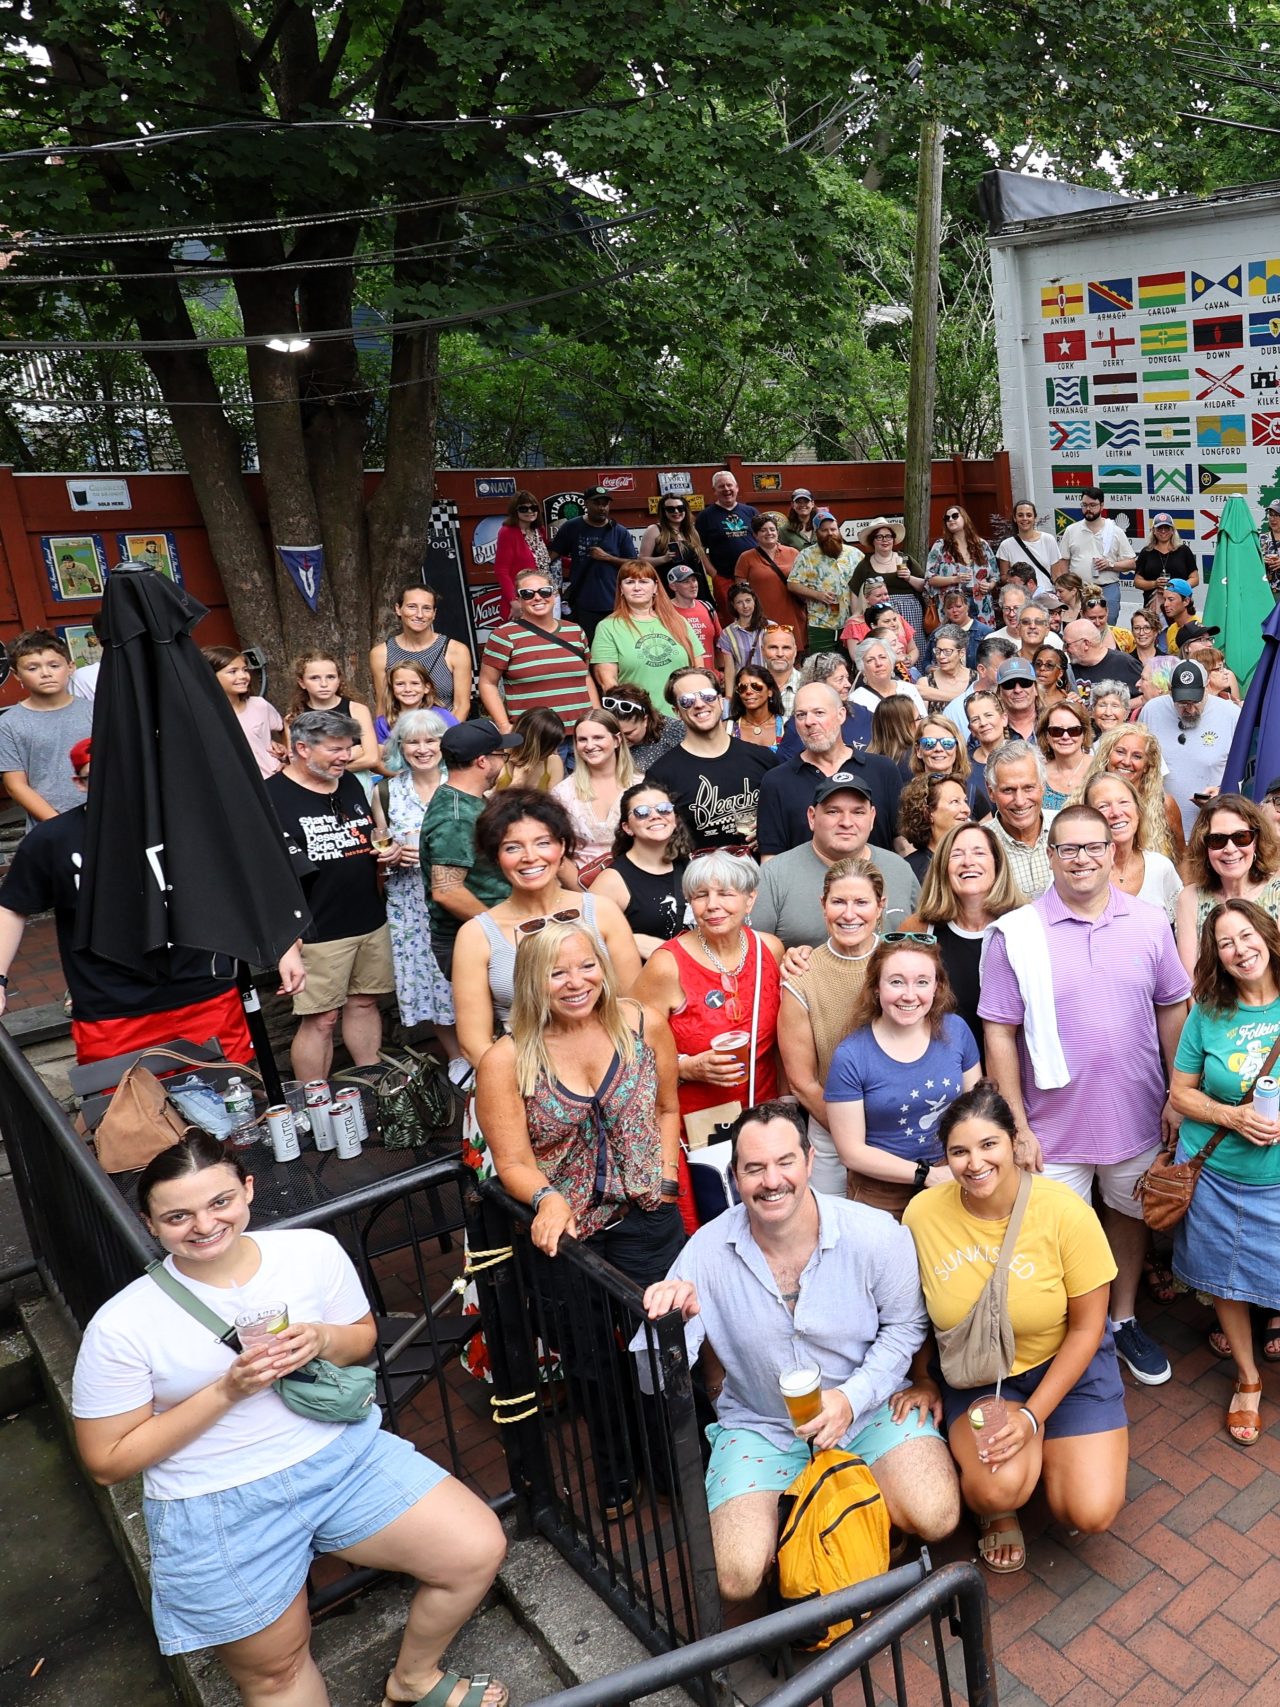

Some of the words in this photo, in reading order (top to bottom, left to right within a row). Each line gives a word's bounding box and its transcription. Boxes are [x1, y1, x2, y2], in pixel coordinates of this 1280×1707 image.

[1204, 301, 1230, 311] CAVAN
[1148, 307, 1177, 316] CARLOW
[1050, 317, 1076, 325] ANTRIM
[1097, 312, 1127, 321] ARMAGH
[1148, 355, 1182, 364] DONEGAL
[1206, 351, 1231, 360] DOWN
[1103, 359, 1124, 367] DERRY
[1103, 405, 1129, 413] GALWAY
[1154, 403, 1177, 411] KERRY
[1204, 400, 1236, 409] KILDARE
[1049, 407, 1088, 415] FERMANAGH
[1152, 449, 1185, 457] LIMERICK
[1202, 447, 1241, 456] LONGFORD
[490, 482, 514, 493] NAVY
[1110, 494, 1132, 502] MEATH
[551, 494, 588, 521] FIRESTO
[689, 774, 760, 830] Bleache
[302, 822, 332, 835] Main
[306, 840, 336, 855] Side
[308, 850, 344, 862] Drink
[934, 1244, 1035, 1281] SUNKISED
